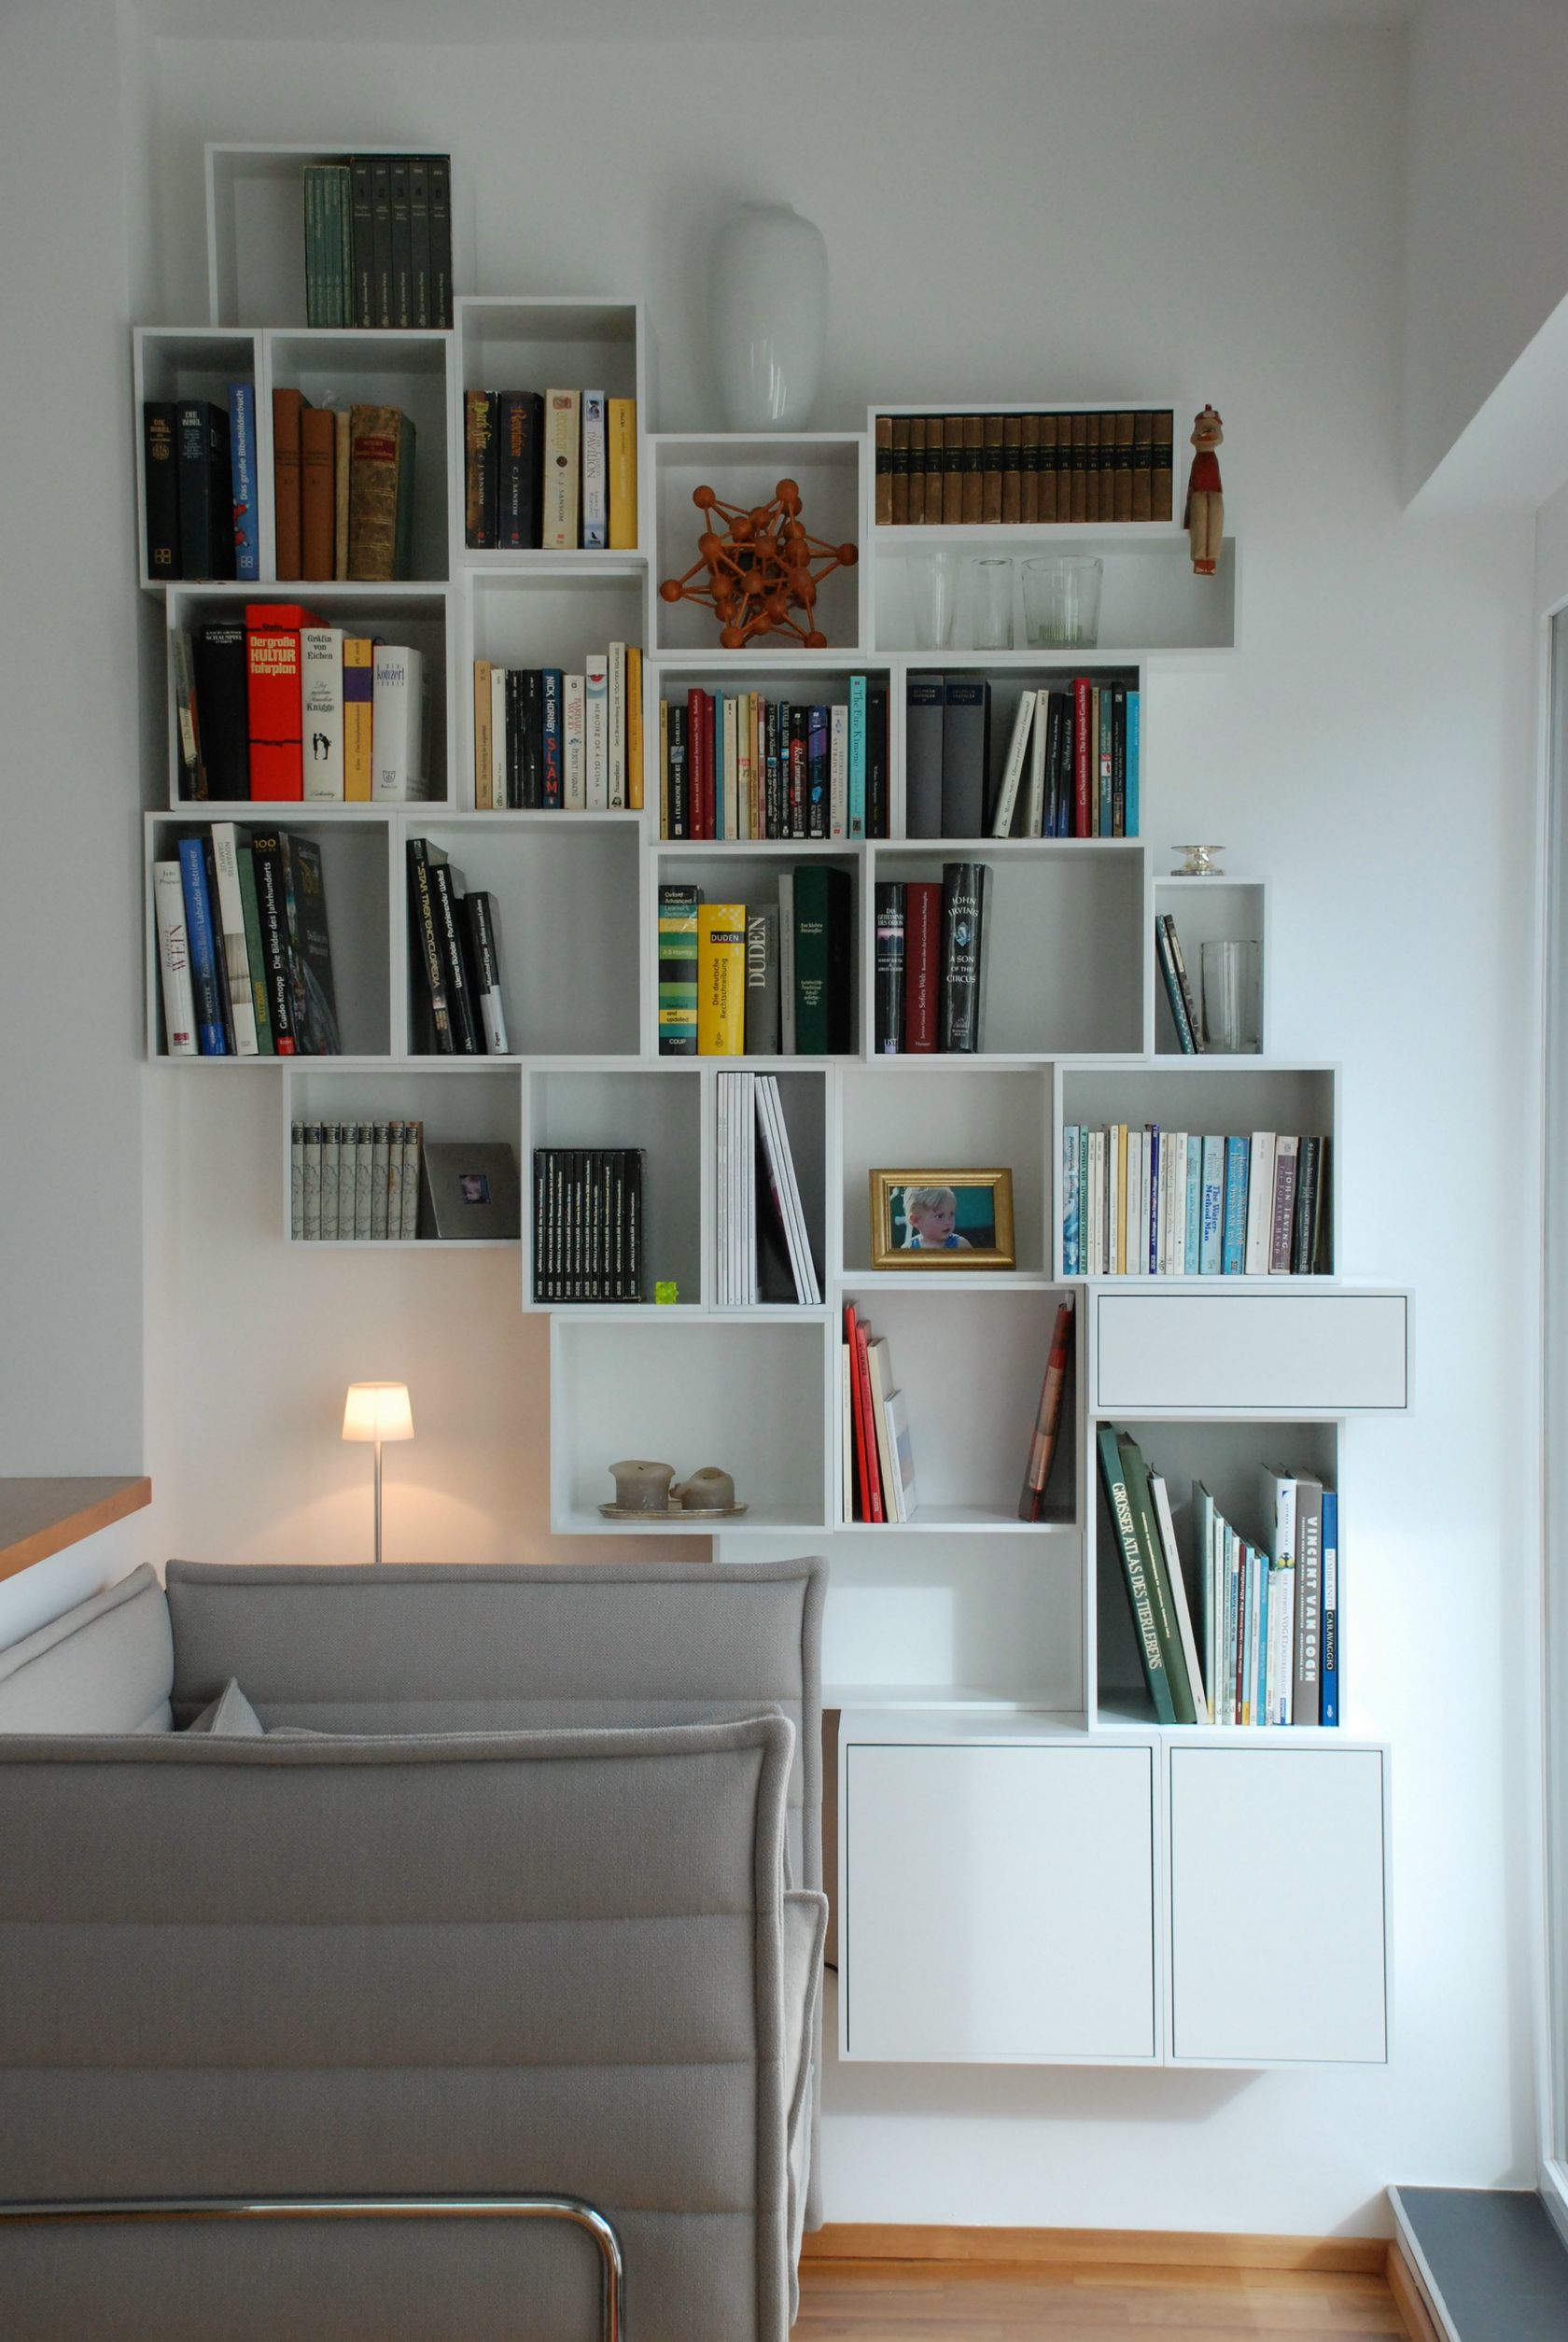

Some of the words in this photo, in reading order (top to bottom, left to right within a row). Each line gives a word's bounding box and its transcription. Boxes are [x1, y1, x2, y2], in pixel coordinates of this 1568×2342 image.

[182, 418, 203, 427] BIBEL
[236, 389, 246, 459] Bibelbilderbuch
[586, 432, 596, 479] PAVILION
[239, 462, 249, 484] große
[240, 487, 248, 500] Das
[251, 649, 296, 662] KULTUR
[251, 663, 296, 676] fahrplan
[308, 652, 333, 660] Eichen
[545, 676, 555, 696] NICK
[853, 690, 862, 708] The
[306, 704, 334, 713] Knigge
[545, 699, 556, 734] HORNBY
[853, 709, 862, 726] Fire
[793, 747, 805, 765] Red
[853, 731, 862, 766] Kimono
[545, 737, 559, 793] SLAM
[225, 841, 233, 876] NOVARTIS
[254, 838, 276, 848] 100
[189, 850, 201, 887] Retriever
[437, 870, 446, 892] Weltall
[263, 862, 277, 914] Jahrhunderts
[192, 889, 205, 924] Labrador
[269, 915, 278, 930] des
[441, 892, 455, 938] Faszinierendes
[947, 907, 979, 917] IRVING
[270, 931, 280, 955] Bilder
[417, 865, 427, 892] STAR
[422, 895, 430, 919] TREK
[426, 920, 440, 989] ENCYCLOPEDIA
[170, 925, 186, 972] WEIN
[272, 956, 282, 970] Die
[449, 941, 459, 965] Büdeler
[735, 947, 739, 956] 1
[748, 916, 766, 989] DUDEN
[275, 976, 287, 1003] Knopp
[454, 965, 463, 989] Werner
[721, 958, 729, 1018] Rechtschreibung
[278, 1003, 288, 1030] Guido
[1284, 1171, 1294, 1203] JOHN
[1275, 1185, 1283, 1223] FOURTH
[1274, 1227, 1282, 1254] HAND
[1281, 1208, 1291, 1249] IRVING
[1113, 1482, 1132, 1535] GROSSER
[1123, 1536, 1141, 1574] ATLAS
[1307, 1516, 1318, 1589] VINCENT
[1131, 1576, 1146, 1598] DES
[1326, 1550, 1335, 1608] REMBRANDT
[1306, 1594, 1316, 1630] VAN
[1137, 1600, 1162, 1670] TIERLEBENS
[1326, 1611, 1335, 1670] CARAVAGGIO
[1306, 1634, 1316, 1682] GOGH
